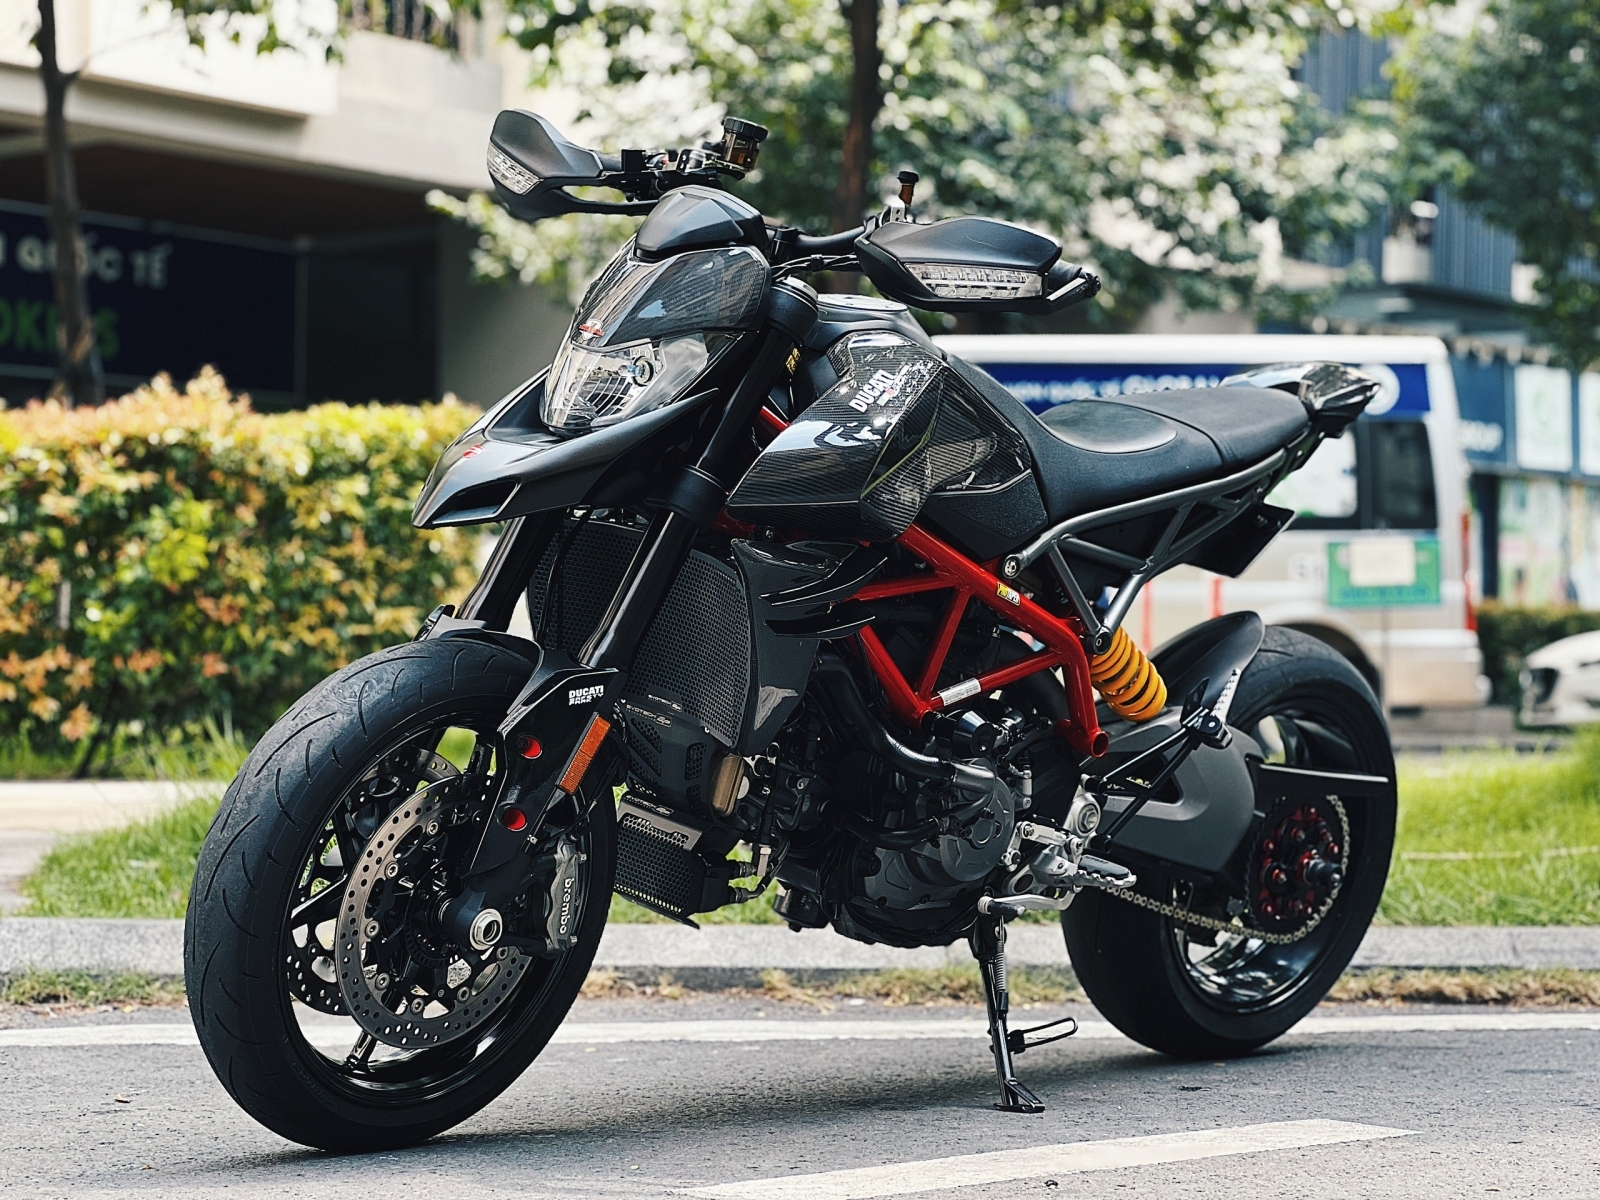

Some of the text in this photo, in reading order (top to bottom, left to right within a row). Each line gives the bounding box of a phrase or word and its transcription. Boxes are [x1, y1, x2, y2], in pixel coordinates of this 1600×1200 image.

[849, 370, 896, 413] DUCATI
[569, 685, 604, 699] DUCATI
[559, 878, 575, 934] brembo
